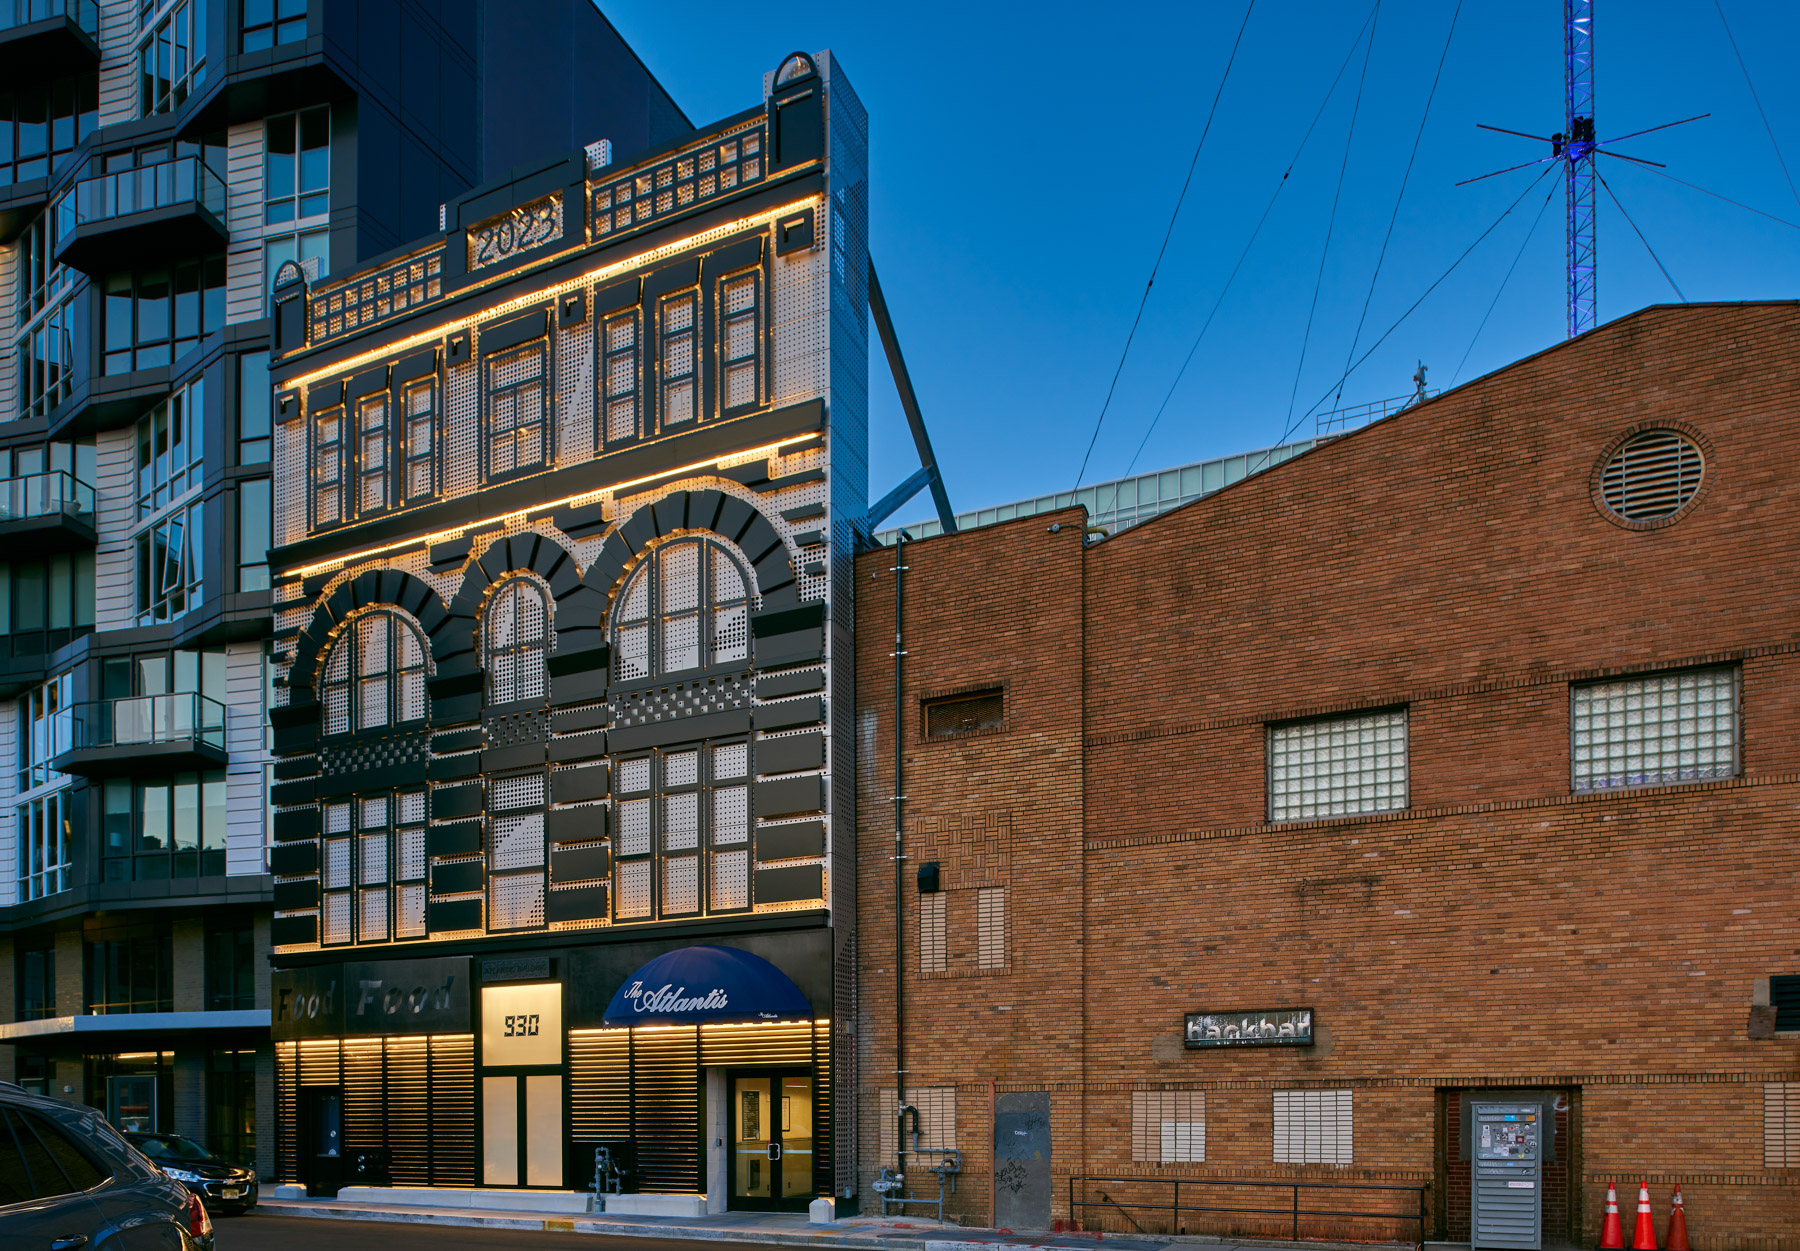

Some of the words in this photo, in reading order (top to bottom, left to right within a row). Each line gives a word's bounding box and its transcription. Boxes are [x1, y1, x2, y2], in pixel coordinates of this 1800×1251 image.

[478, 203, 556, 264] 2023
[277, 980, 336, 1021] Food
[356, 975, 455, 1016] Food
[623, 980, 643, 999] The
[633, 984, 729, 1013] Atlantis
[503, 1014, 540, 1038] 930
